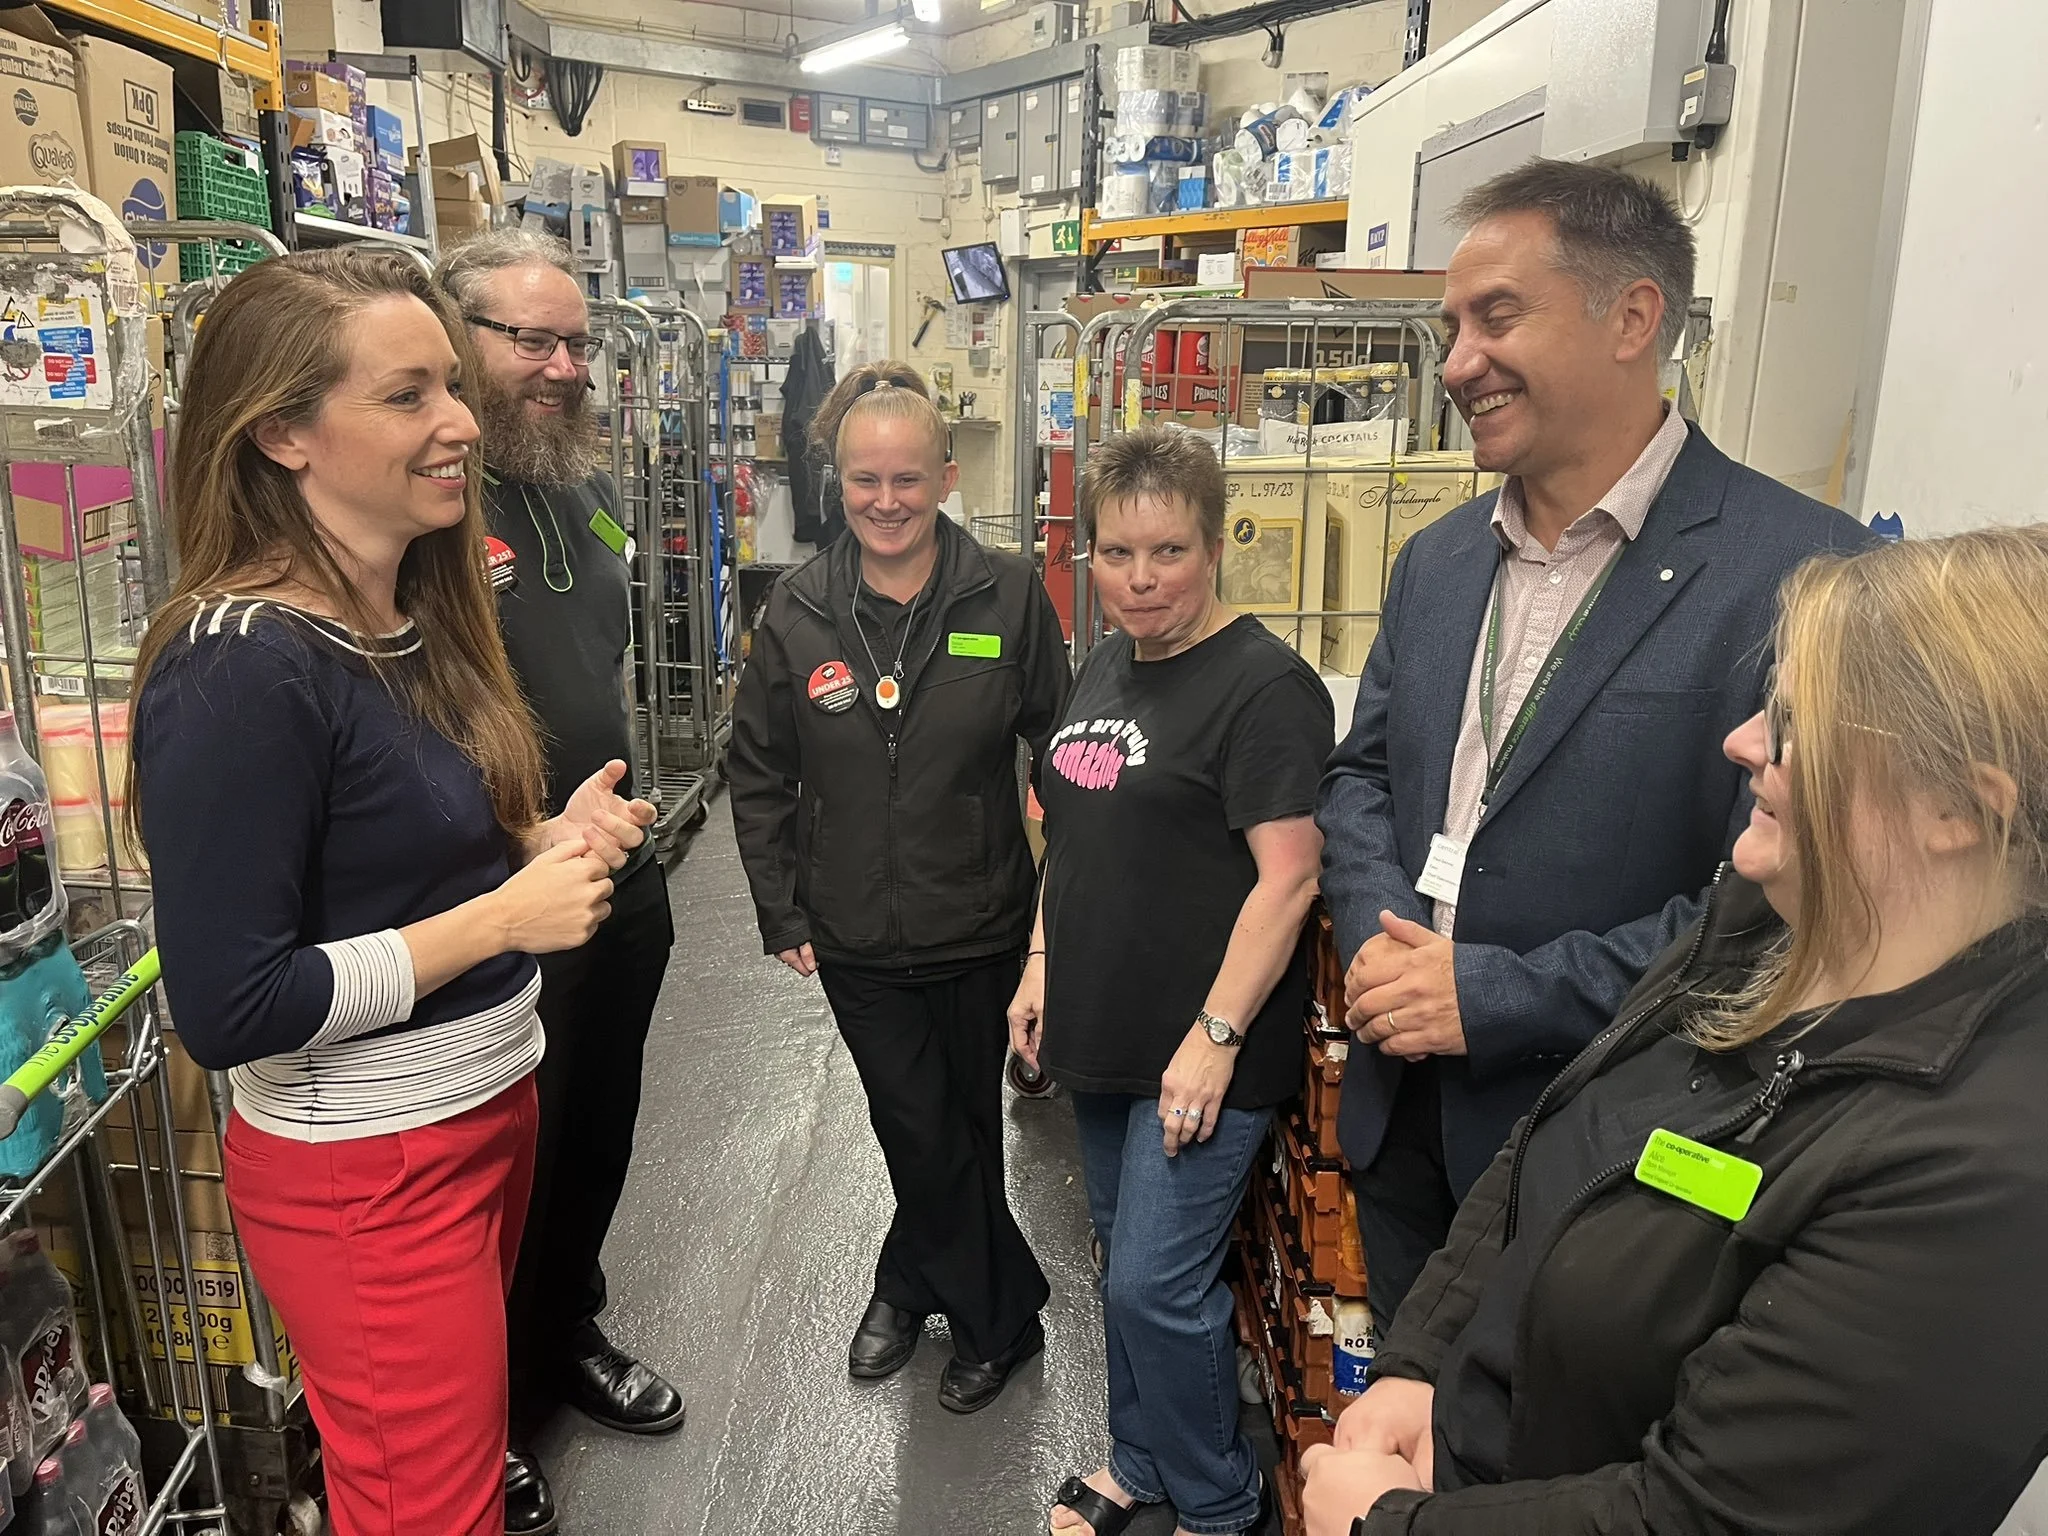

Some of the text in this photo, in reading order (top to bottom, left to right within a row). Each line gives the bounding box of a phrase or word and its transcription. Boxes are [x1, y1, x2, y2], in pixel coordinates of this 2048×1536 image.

[131, 87, 154, 125] 6PK
[107, 121, 132, 141] Crisps
[32, 142, 74, 170] Quavers
[114, 142, 139, 164] Onion
[147, 152, 168, 174] Cheese
[1193, 385, 1226, 402] PRINGLS
[1321, 432, 1378, 444] COCKTAILS
[812, 679, 840, 695] UNDER
[1495, 656, 1564, 773] We are the difference makers
[1089, 719, 1125, 735] are
[1655, 1136, 1710, 1164] The co-operative
